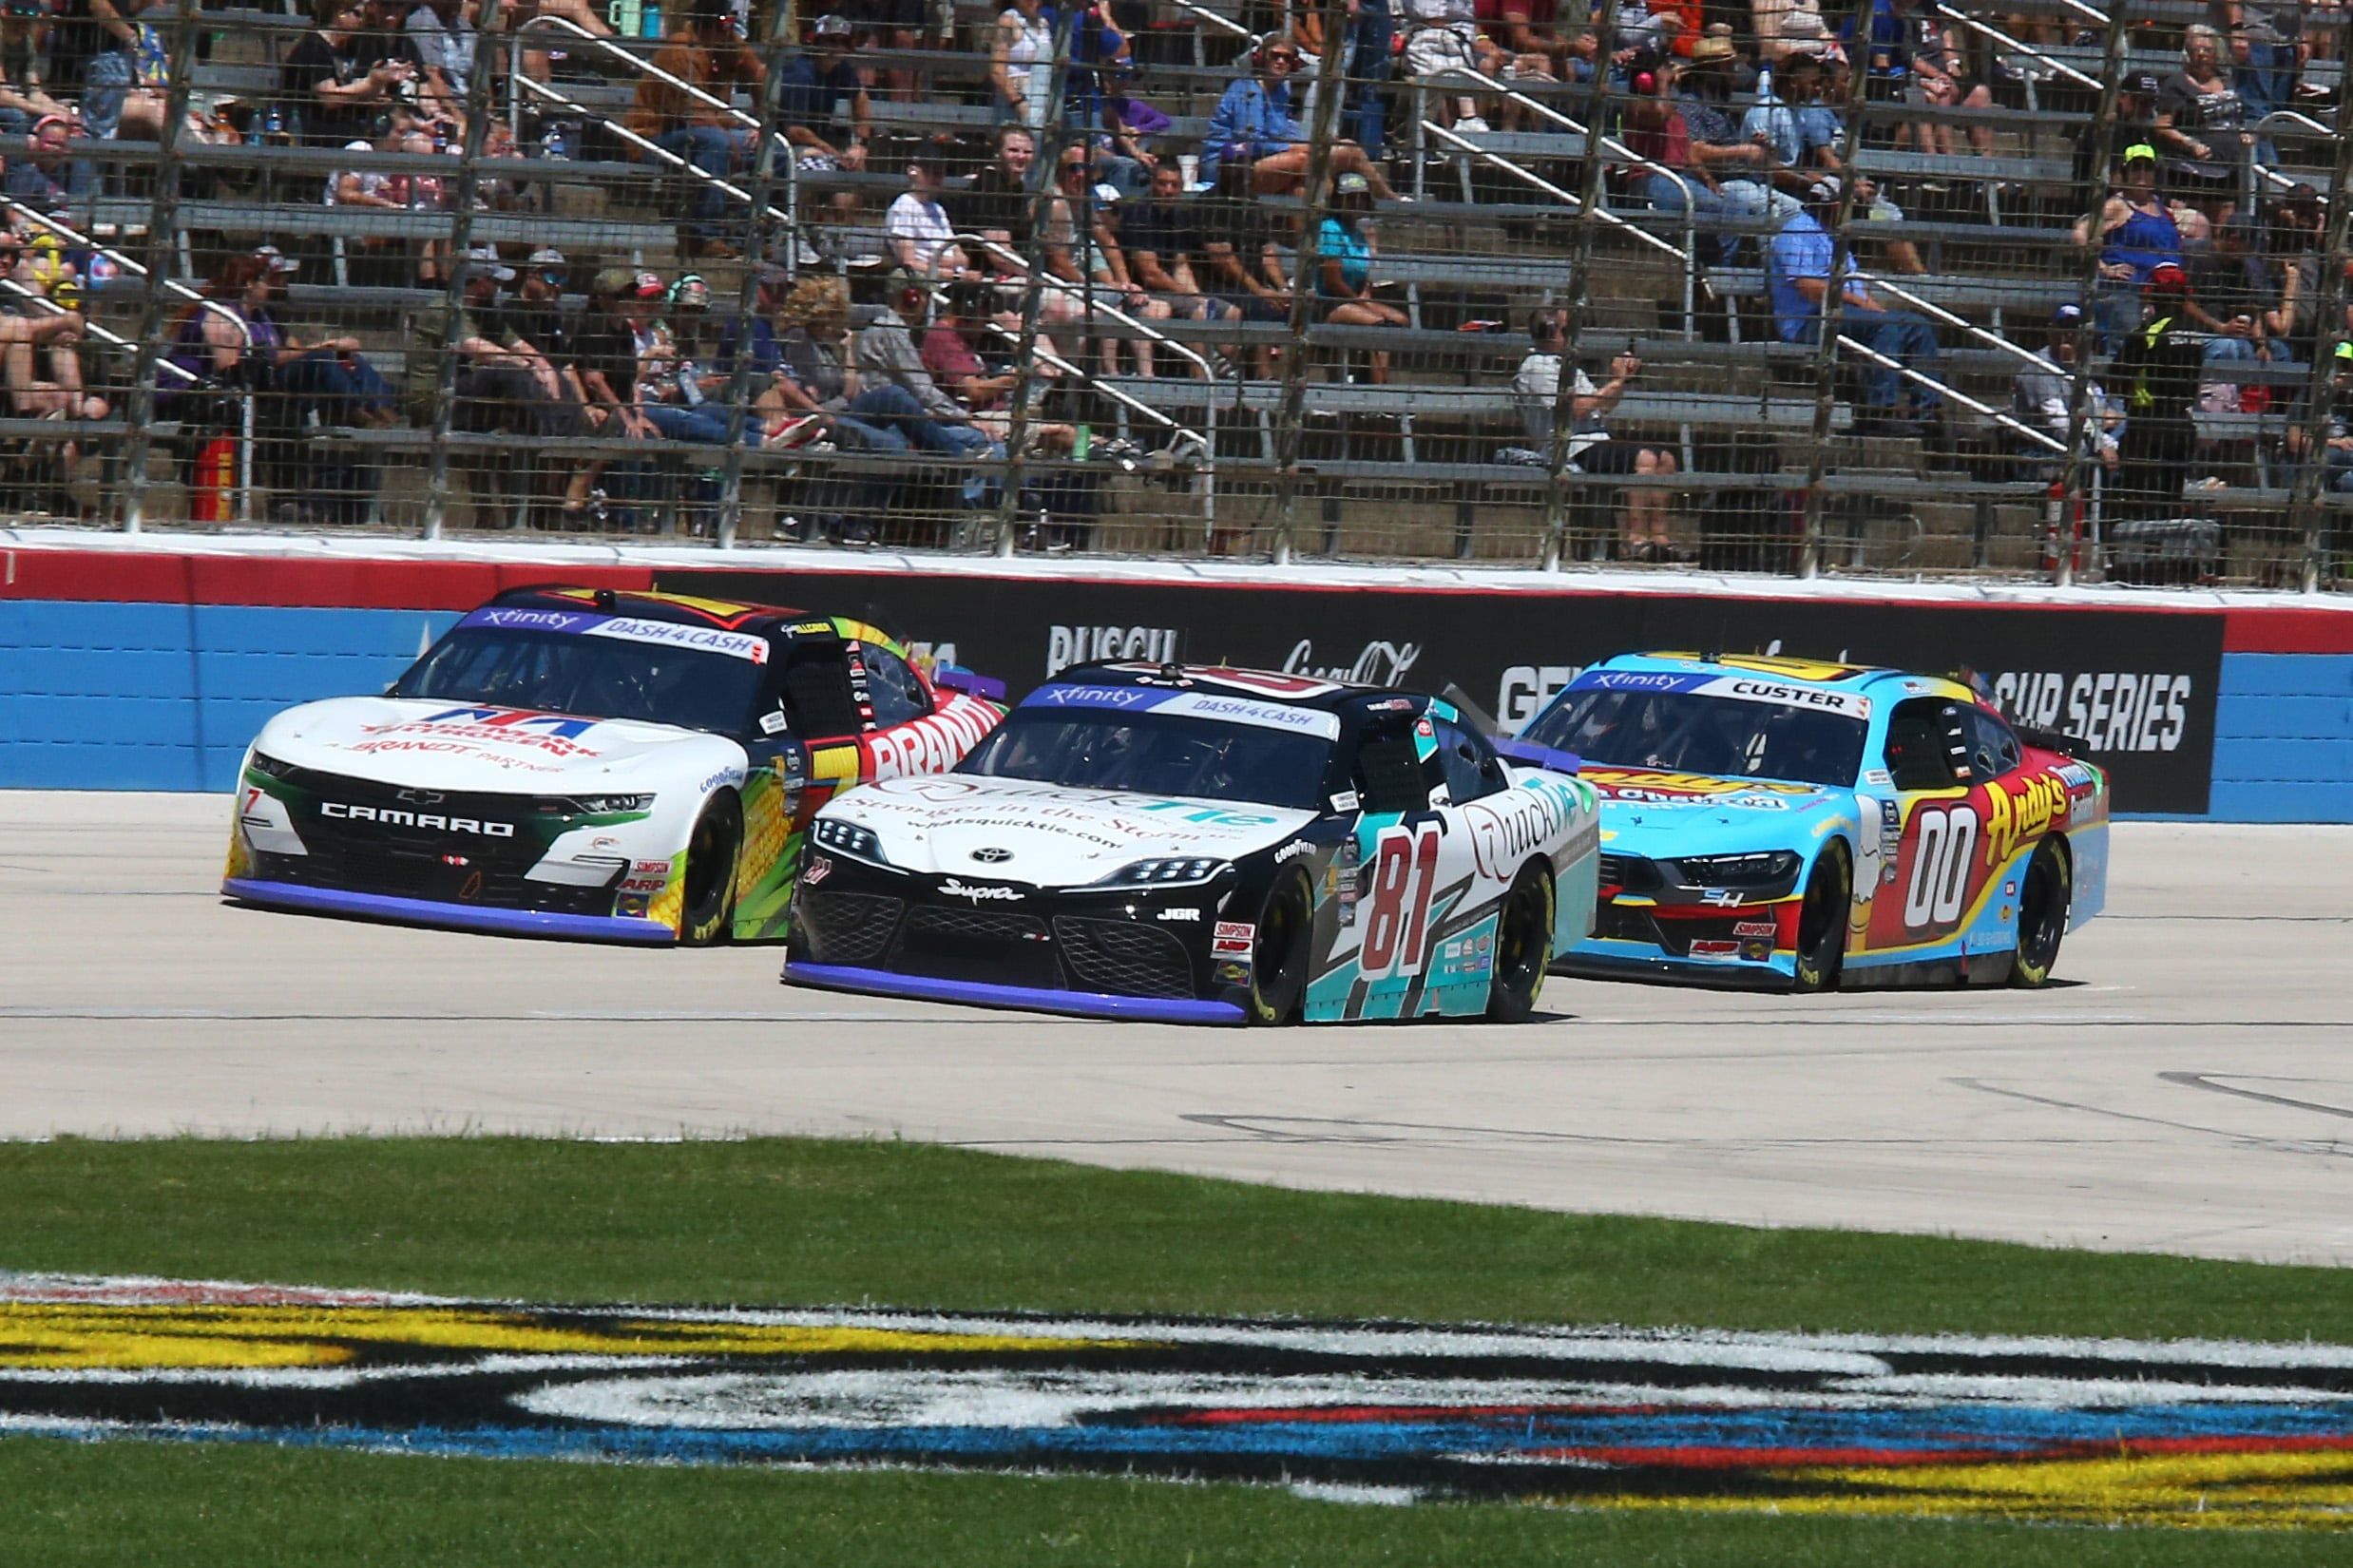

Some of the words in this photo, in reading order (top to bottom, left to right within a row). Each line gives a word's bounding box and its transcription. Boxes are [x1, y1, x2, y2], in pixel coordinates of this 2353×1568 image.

[484, 608, 581, 629] xfinity
[607, 621, 672, 640] DASH
[672, 629, 686, 641] 4
[689, 631, 754, 653] CASH
[1594, 673, 1687, 690] xfinity
[1046, 686, 1145, 707] xfinity
[1731, 681, 1846, 709] CUSTER
[1193, 699, 1245, 716] DASH
[1246, 706, 1258, 717] 4
[1261, 708, 1313, 726] CASH
[2064, 673, 2191, 752] SERIES
[476, 752, 565, 773] PARTNER
[243, 788, 264, 814] 7
[321, 801, 514, 837] CAMARO
[1982, 773, 2067, 867] Andy's
[1903, 805, 1980, 928] 00
[619, 878, 665, 891] ARP
[937, 877, 1025, 906] Supra
[1359, 820, 1444, 982] 81
[1157, 908, 1200, 922] JGR
[1216, 923, 1253, 937] SIMPSON
[1735, 923, 1774, 935] SIMPSON
